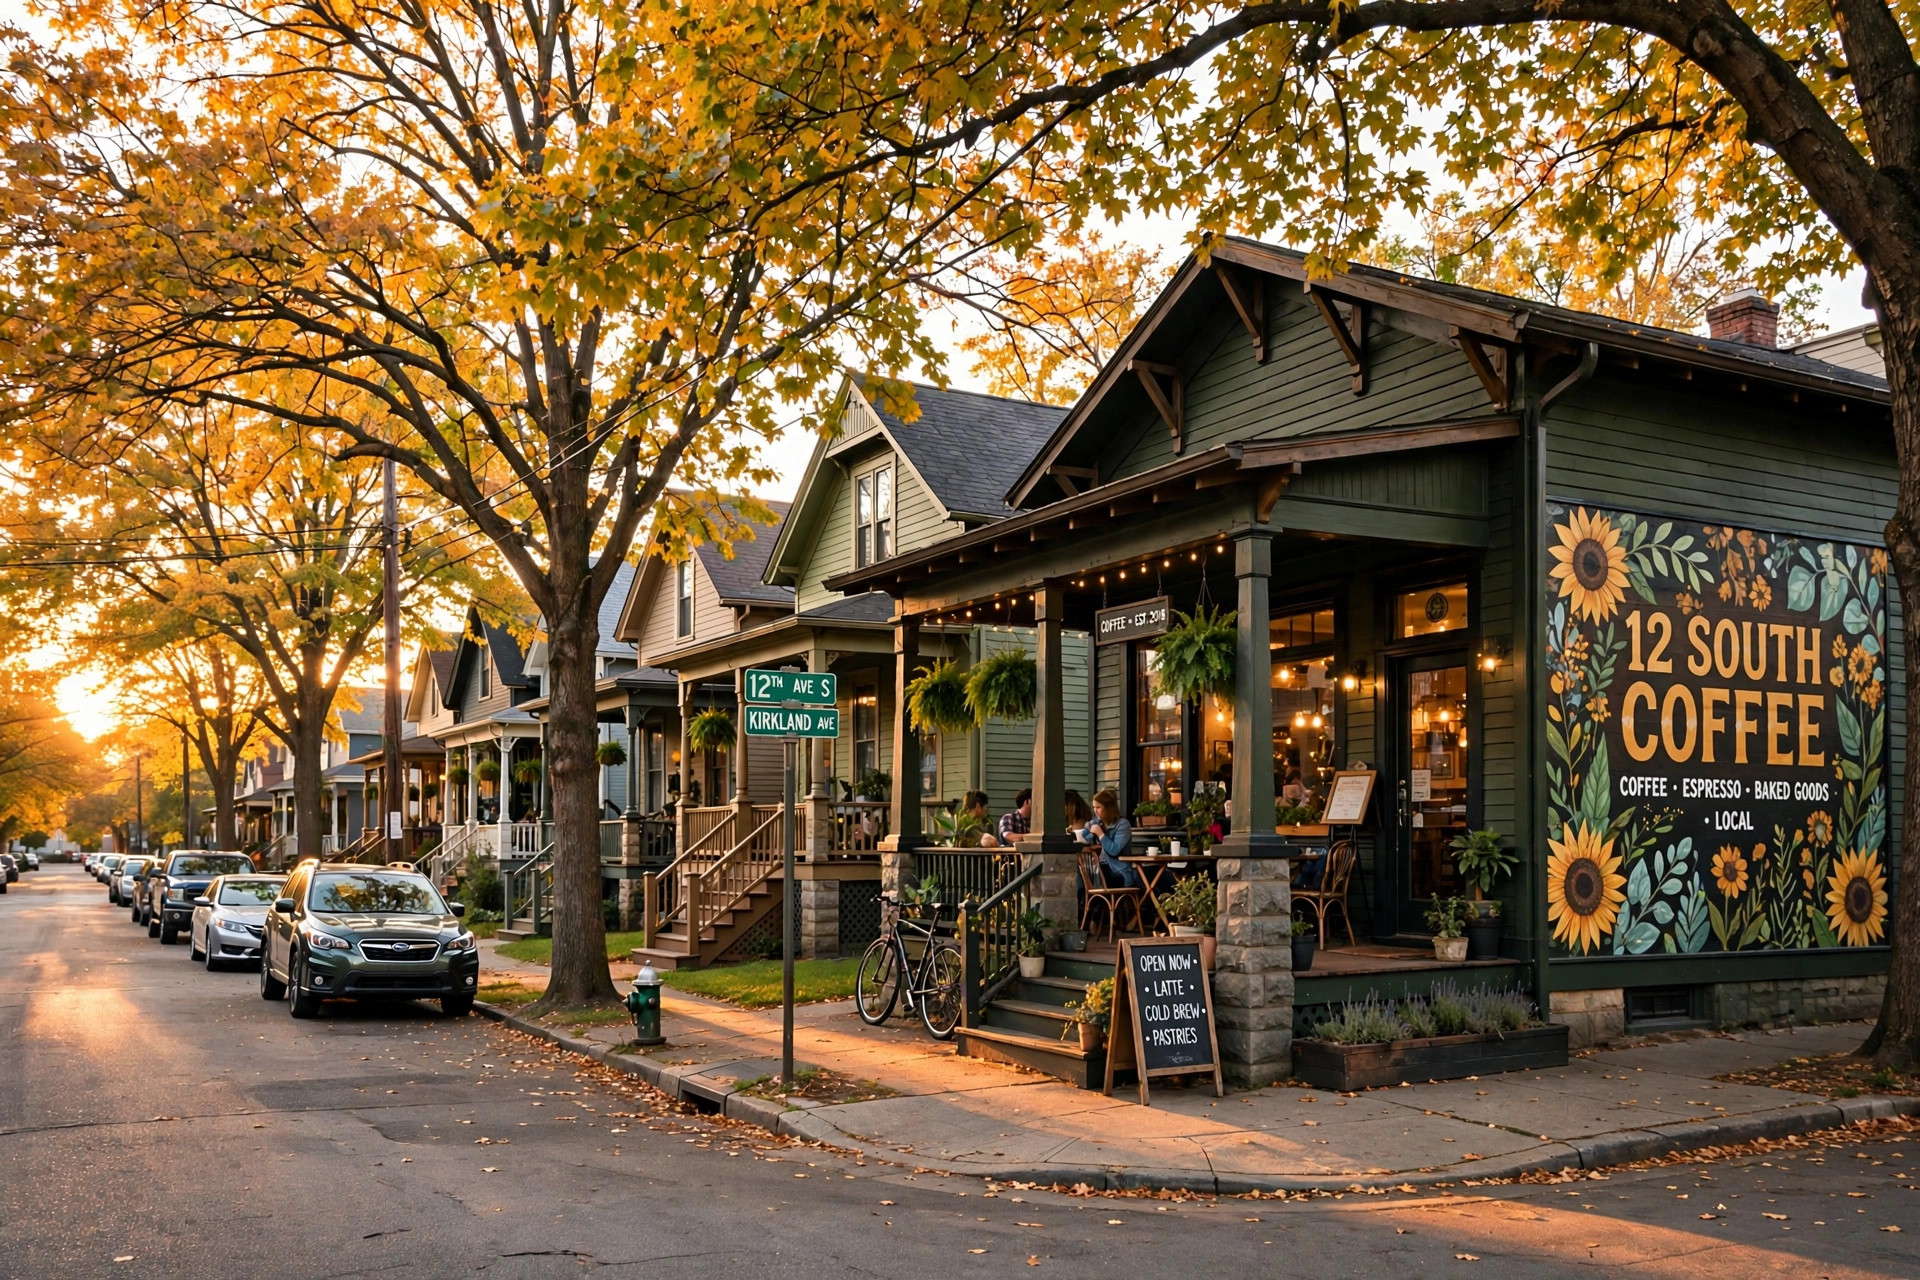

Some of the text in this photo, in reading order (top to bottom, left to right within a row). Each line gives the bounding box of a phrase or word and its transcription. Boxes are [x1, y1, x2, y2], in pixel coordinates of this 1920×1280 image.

[1100, 617, 1126, 633] COFFEE
[1625, 609, 1822, 685] 12 SOUTH
[749, 673, 830, 698] 12TH AVE S
[749, 711, 835, 731] KIRKLAND AVE
[1621, 681, 1825, 767] COFFEE
[1619, 775, 1829, 802] COFFEE ESPRESSO BAKED GOODS
[1715, 811, 1754, 831] LOCAL
[1140, 953, 1191, 972] OPEN NOW
[1154, 979, 1185, 997] LATTE
[1145, 1002, 1200, 1022] COLD BREW
[1152, 1027, 1198, 1046] PASTRIES
